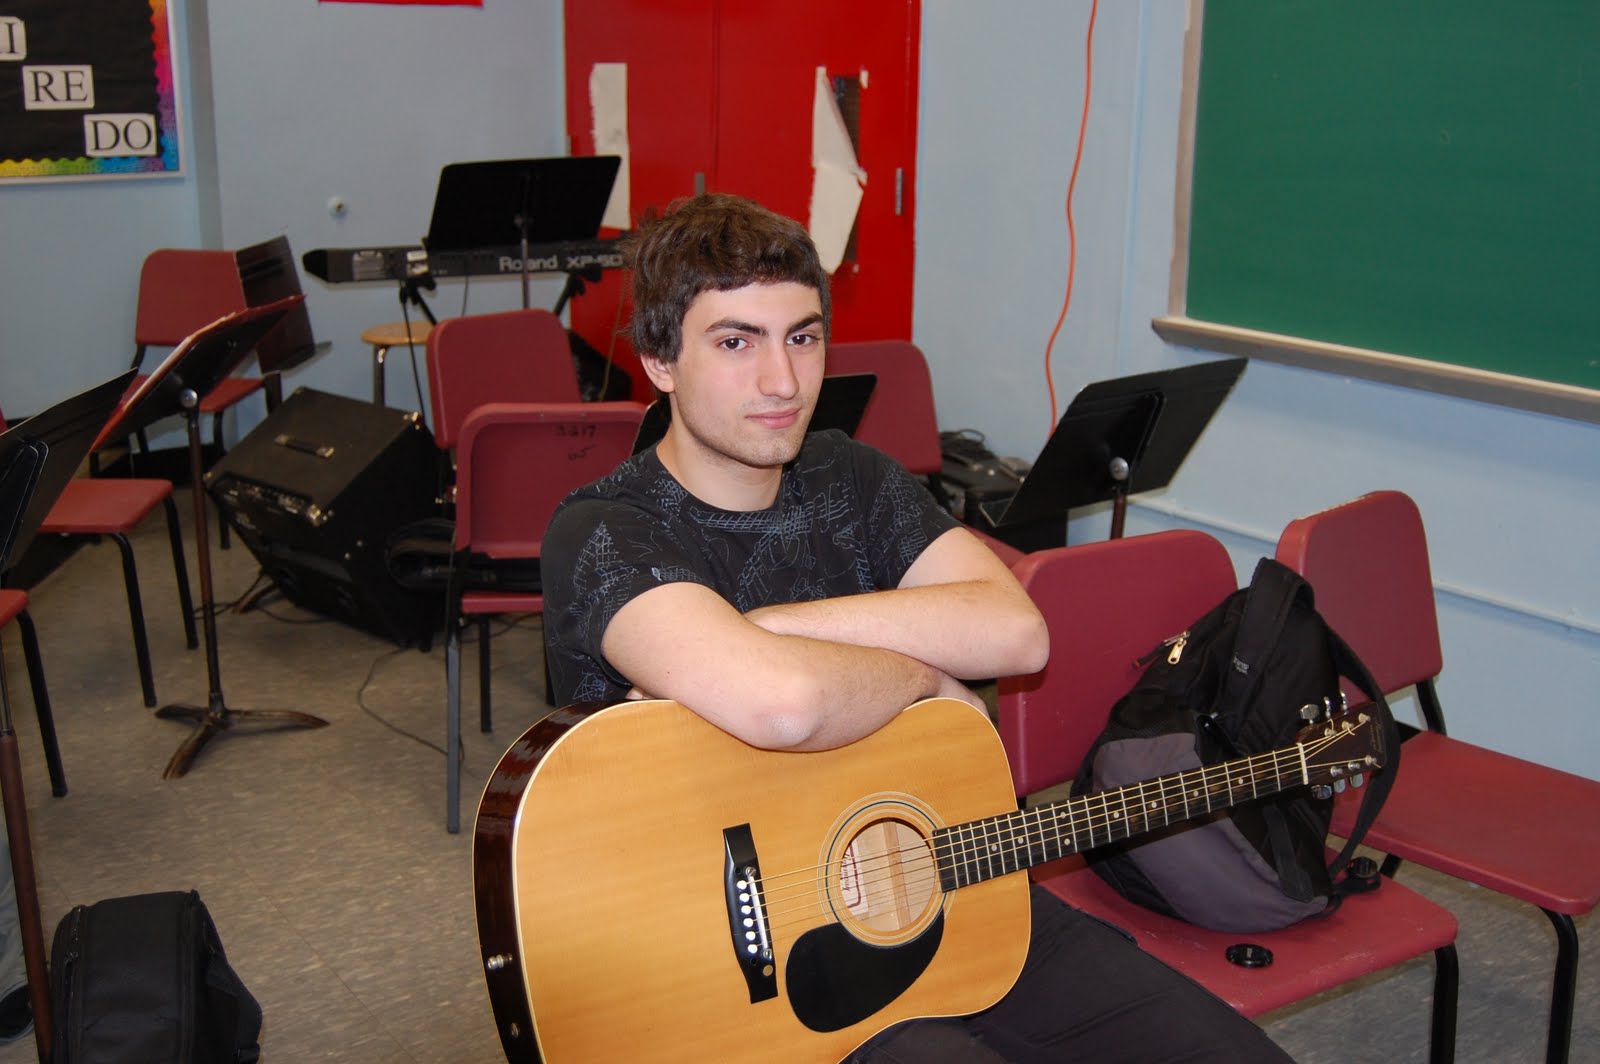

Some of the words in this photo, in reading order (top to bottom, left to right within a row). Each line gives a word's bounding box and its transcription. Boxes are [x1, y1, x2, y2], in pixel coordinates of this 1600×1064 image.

[0, 22, 20, 54] I
[29, 70, 88, 102] RE
[89, 119, 152, 150] DO
[498, 254, 558, 273] Roand
